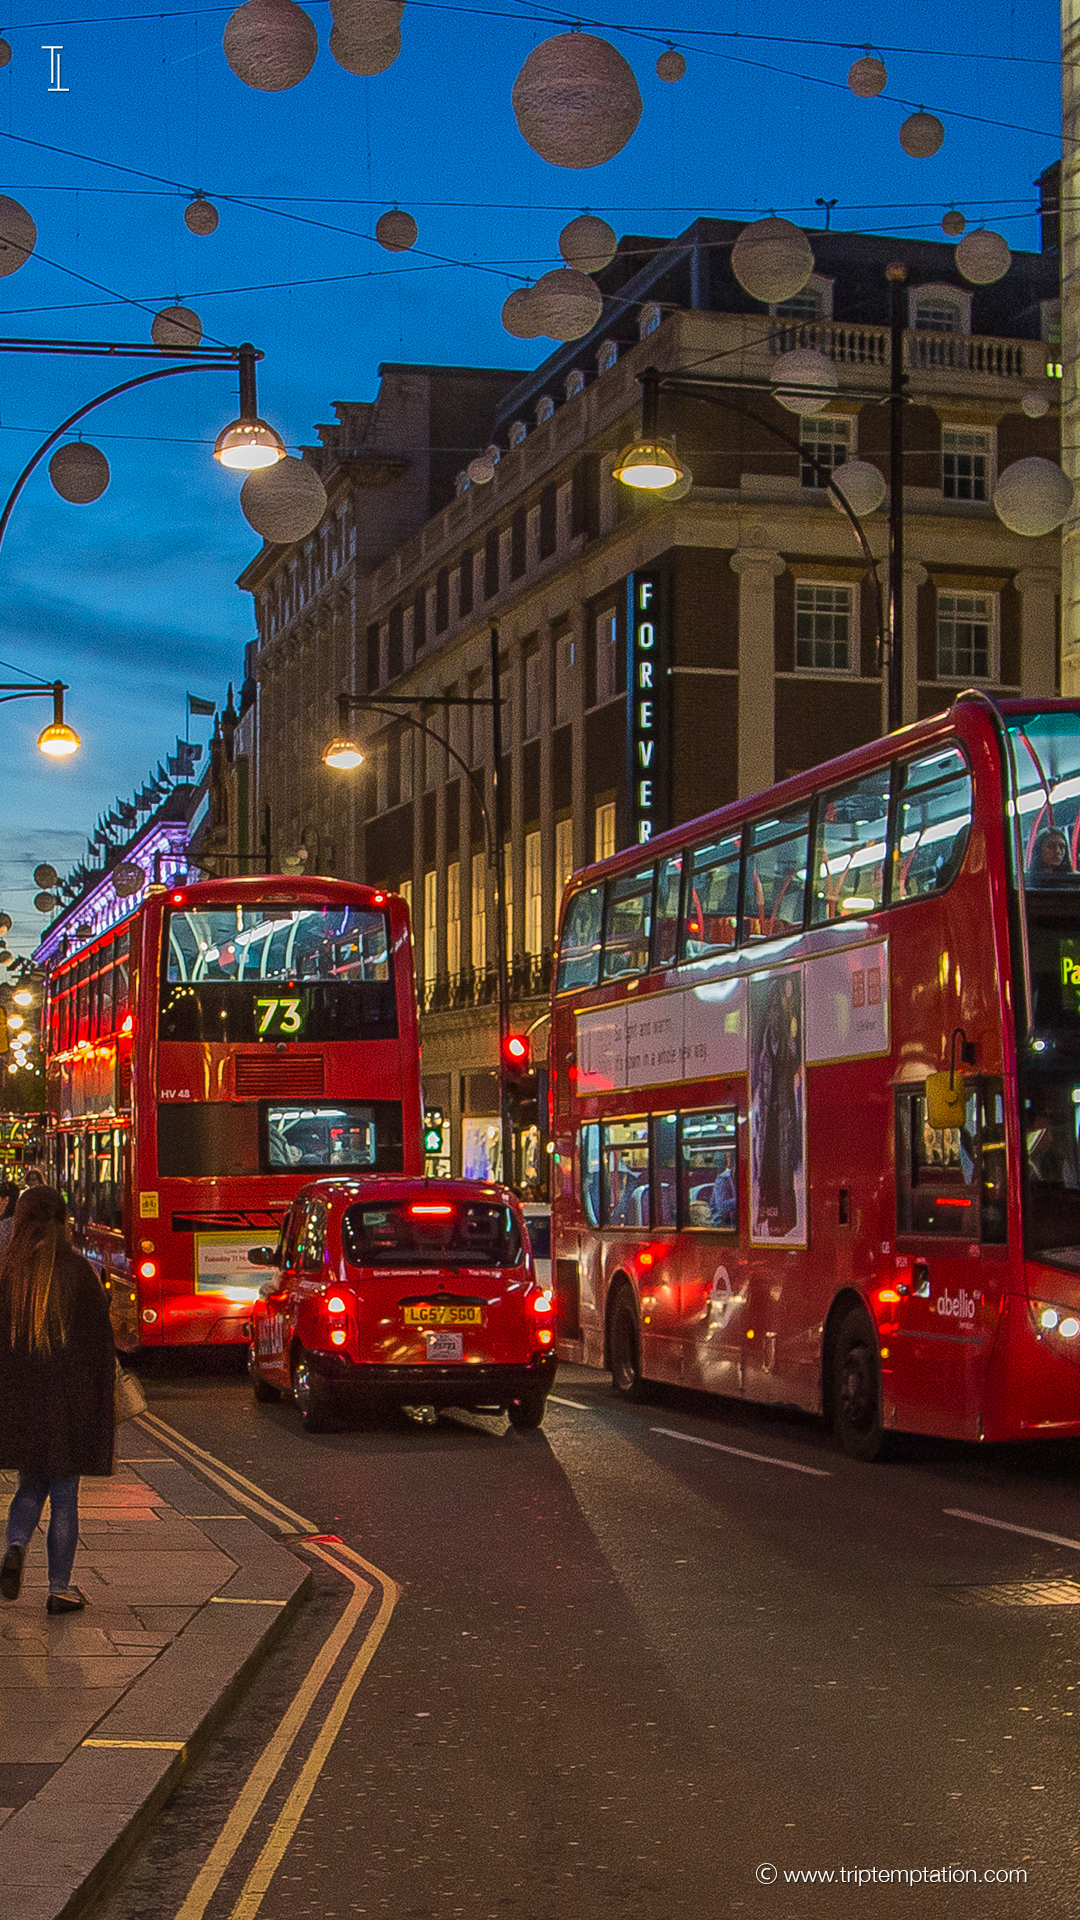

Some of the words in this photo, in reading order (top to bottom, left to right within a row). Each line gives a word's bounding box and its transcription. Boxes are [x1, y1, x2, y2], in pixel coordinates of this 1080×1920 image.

[638, 582, 655, 845] FOREVER
[257, 998, 303, 1034] 73
[161, 1089, 177, 1099] HV
[178, 1089, 190, 1099] 48
[410, 1308, 446, 1321] LG57
[937, 1288, 976, 1319] abellio
